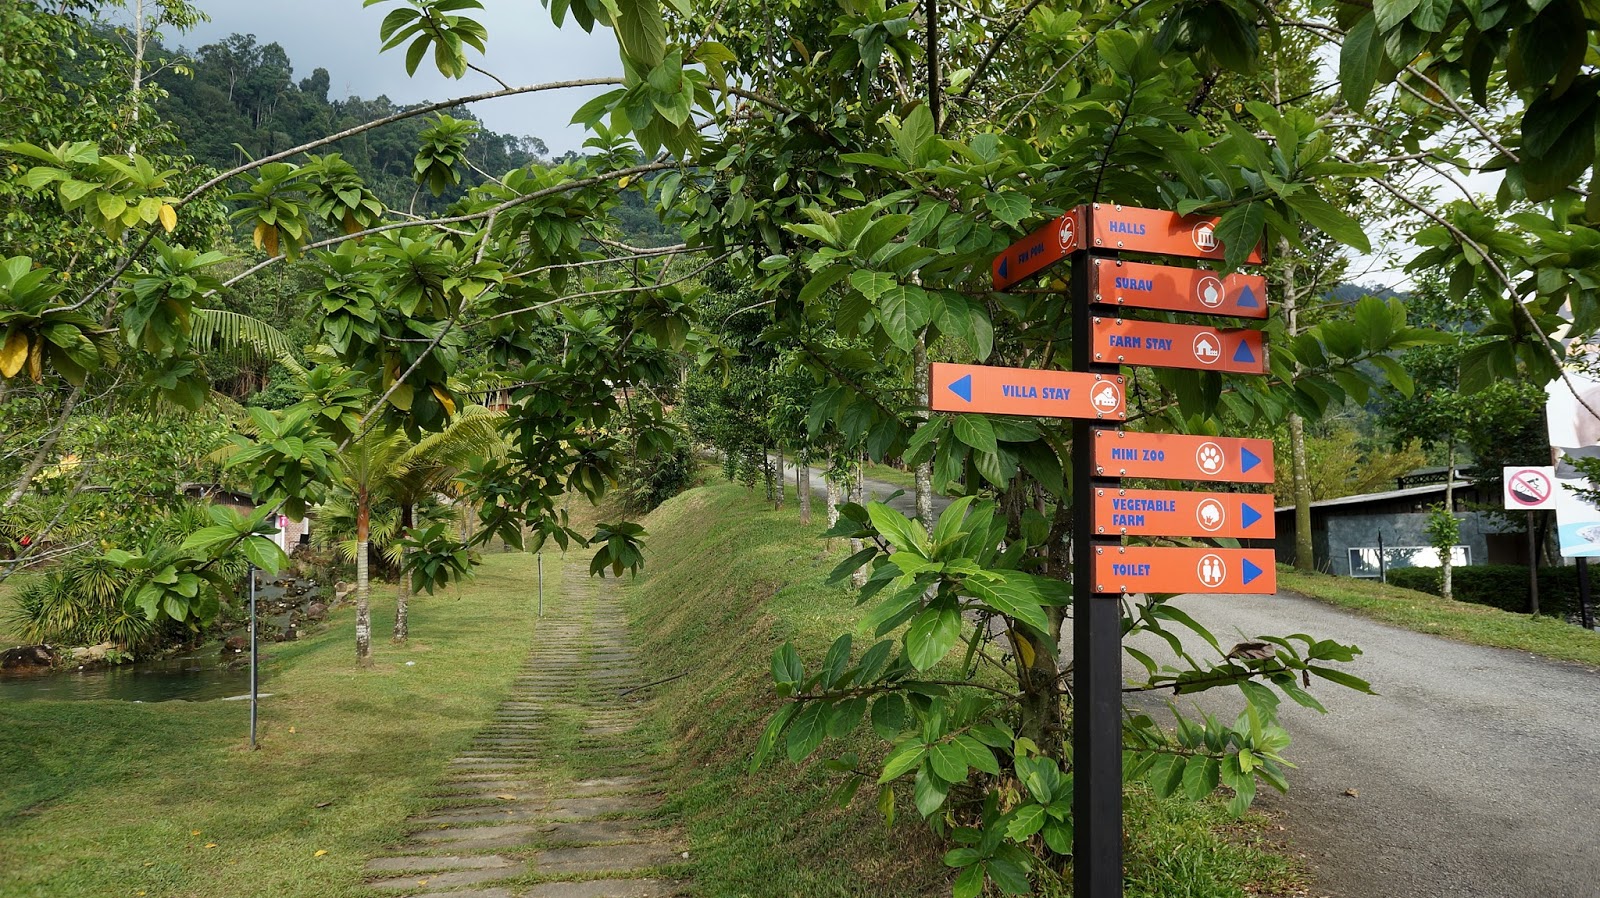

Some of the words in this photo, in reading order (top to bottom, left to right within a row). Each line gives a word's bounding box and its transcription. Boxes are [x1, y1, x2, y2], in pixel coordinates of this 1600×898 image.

[1109, 220, 1146, 236] HALLS
[1115, 277, 1153, 292] SURAU
[1109, 335, 1141, 349] FARM
[1145, 337, 1173, 351] STAY
[1002, 385, 1038, 398] VILLA
[1042, 387, 1071, 401] STAY
[1111, 448, 1138, 461] MINI
[1142, 449, 1165, 462] ZOO
[1112, 498, 1176, 513] VEGETABLE
[1112, 513, 1145, 526] FARM
[1112, 563, 1151, 576] TOILET
